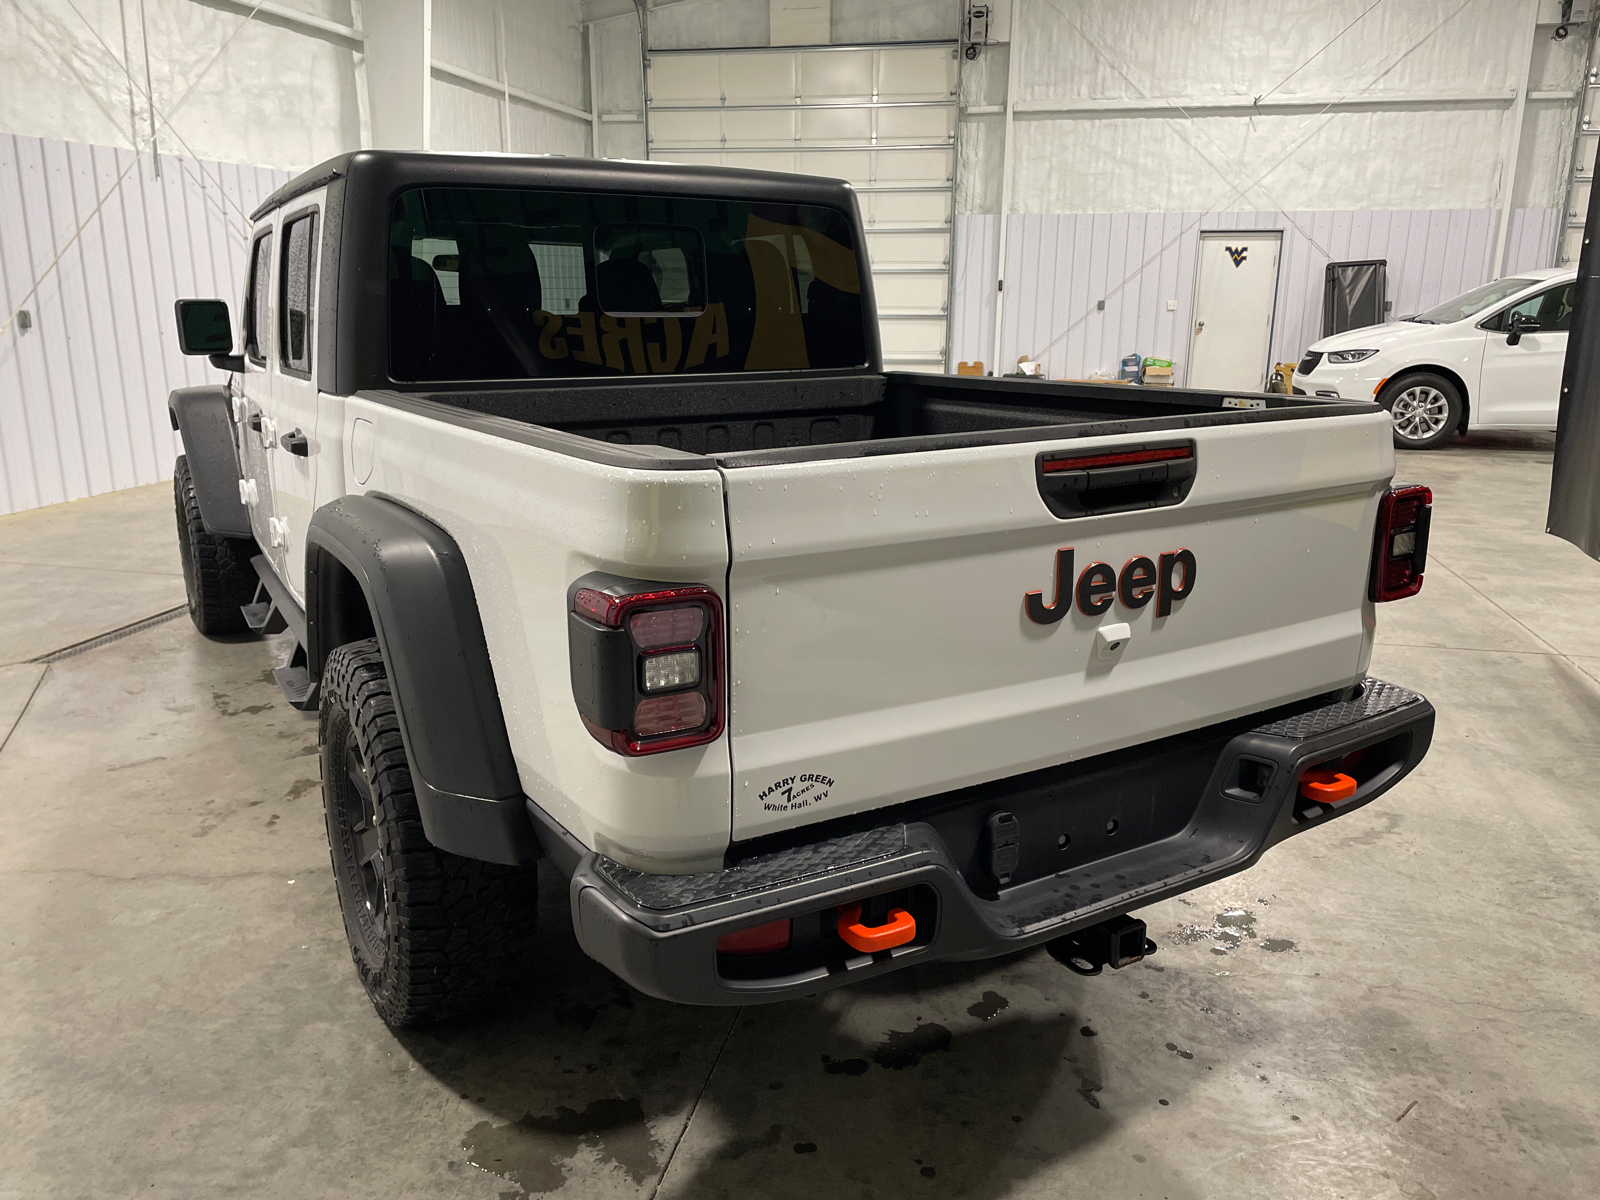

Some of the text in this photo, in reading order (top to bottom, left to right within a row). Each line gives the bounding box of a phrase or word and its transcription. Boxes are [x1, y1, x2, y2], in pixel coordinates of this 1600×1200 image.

[1025, 546, 1196, 625] Jeep
[758, 774, 835, 801] HARRY GREEN
[781, 783, 815, 803] 7 ACRES
[763, 790, 829, 811] White Hall, WV
